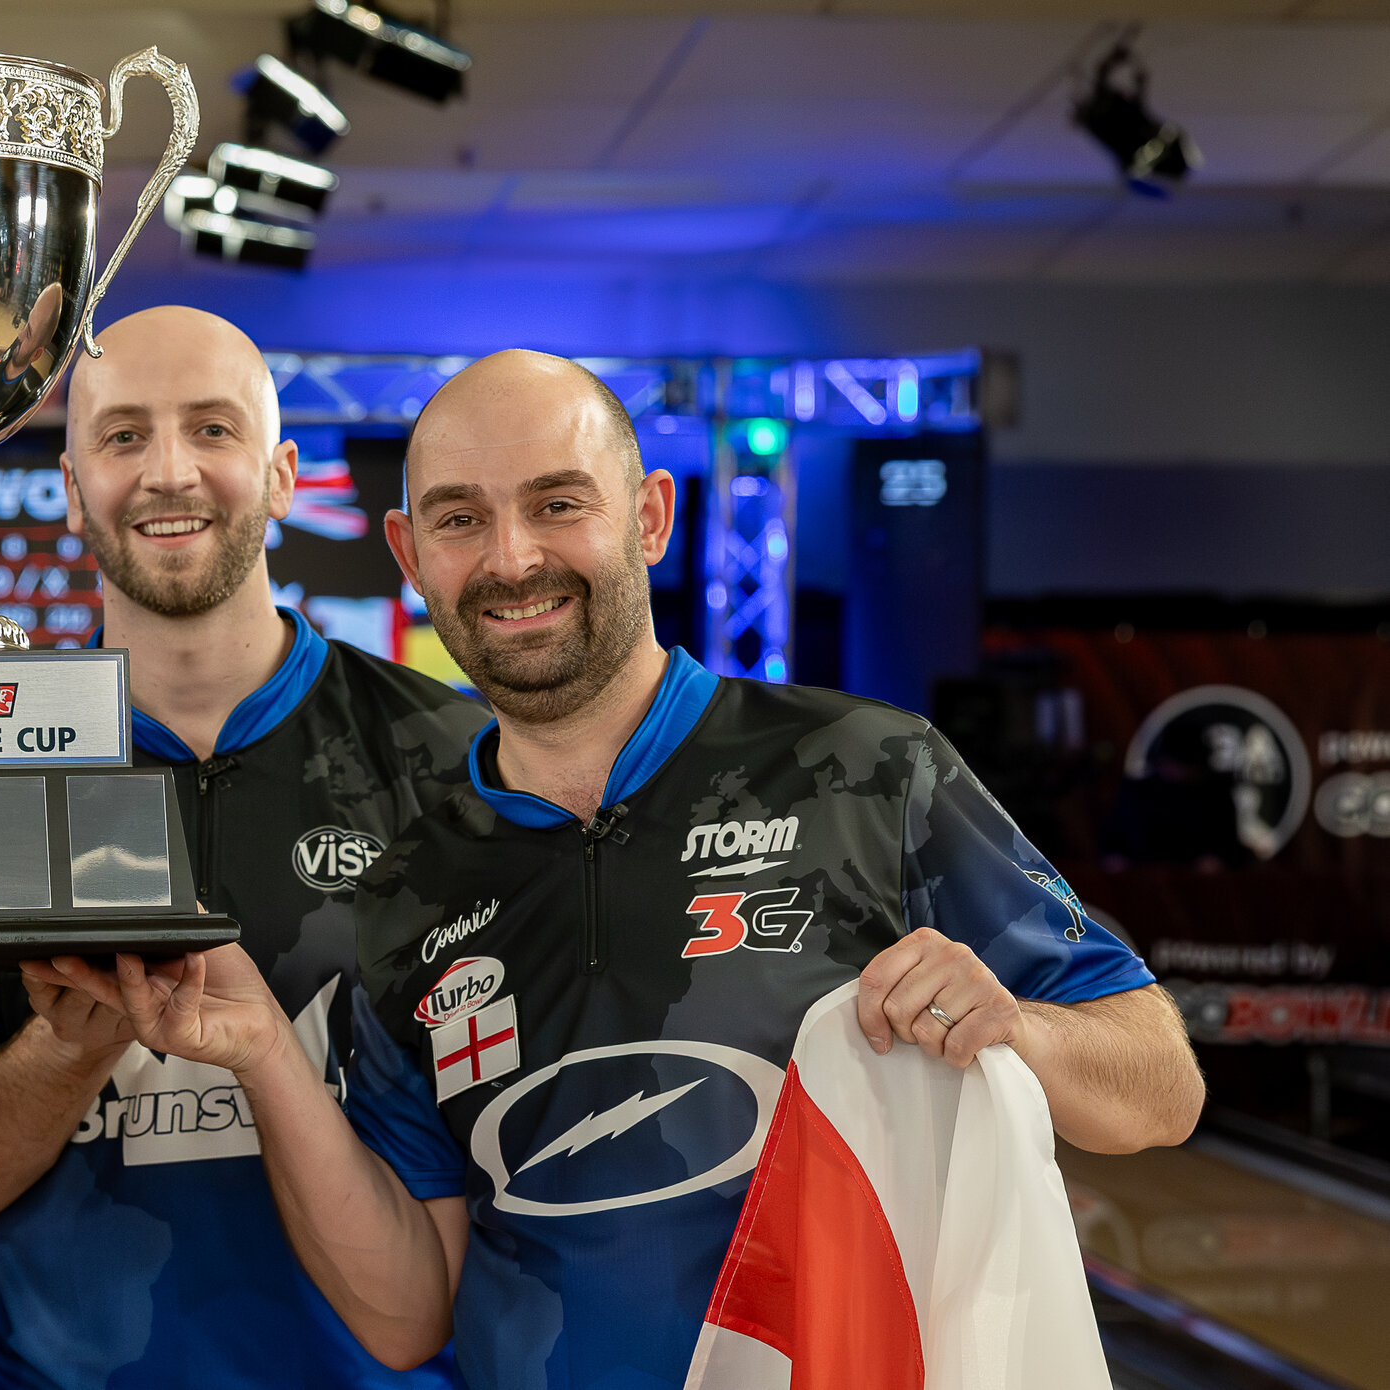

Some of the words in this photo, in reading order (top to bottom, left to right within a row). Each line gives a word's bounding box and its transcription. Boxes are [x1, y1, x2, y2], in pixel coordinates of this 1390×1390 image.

[16, 727, 77, 753] CUP
[680, 816, 800, 862] STORM
[421, 898, 500, 963] Coolwick
[681, 887, 814, 959] 3G
[430, 974, 495, 1016] Turbo
